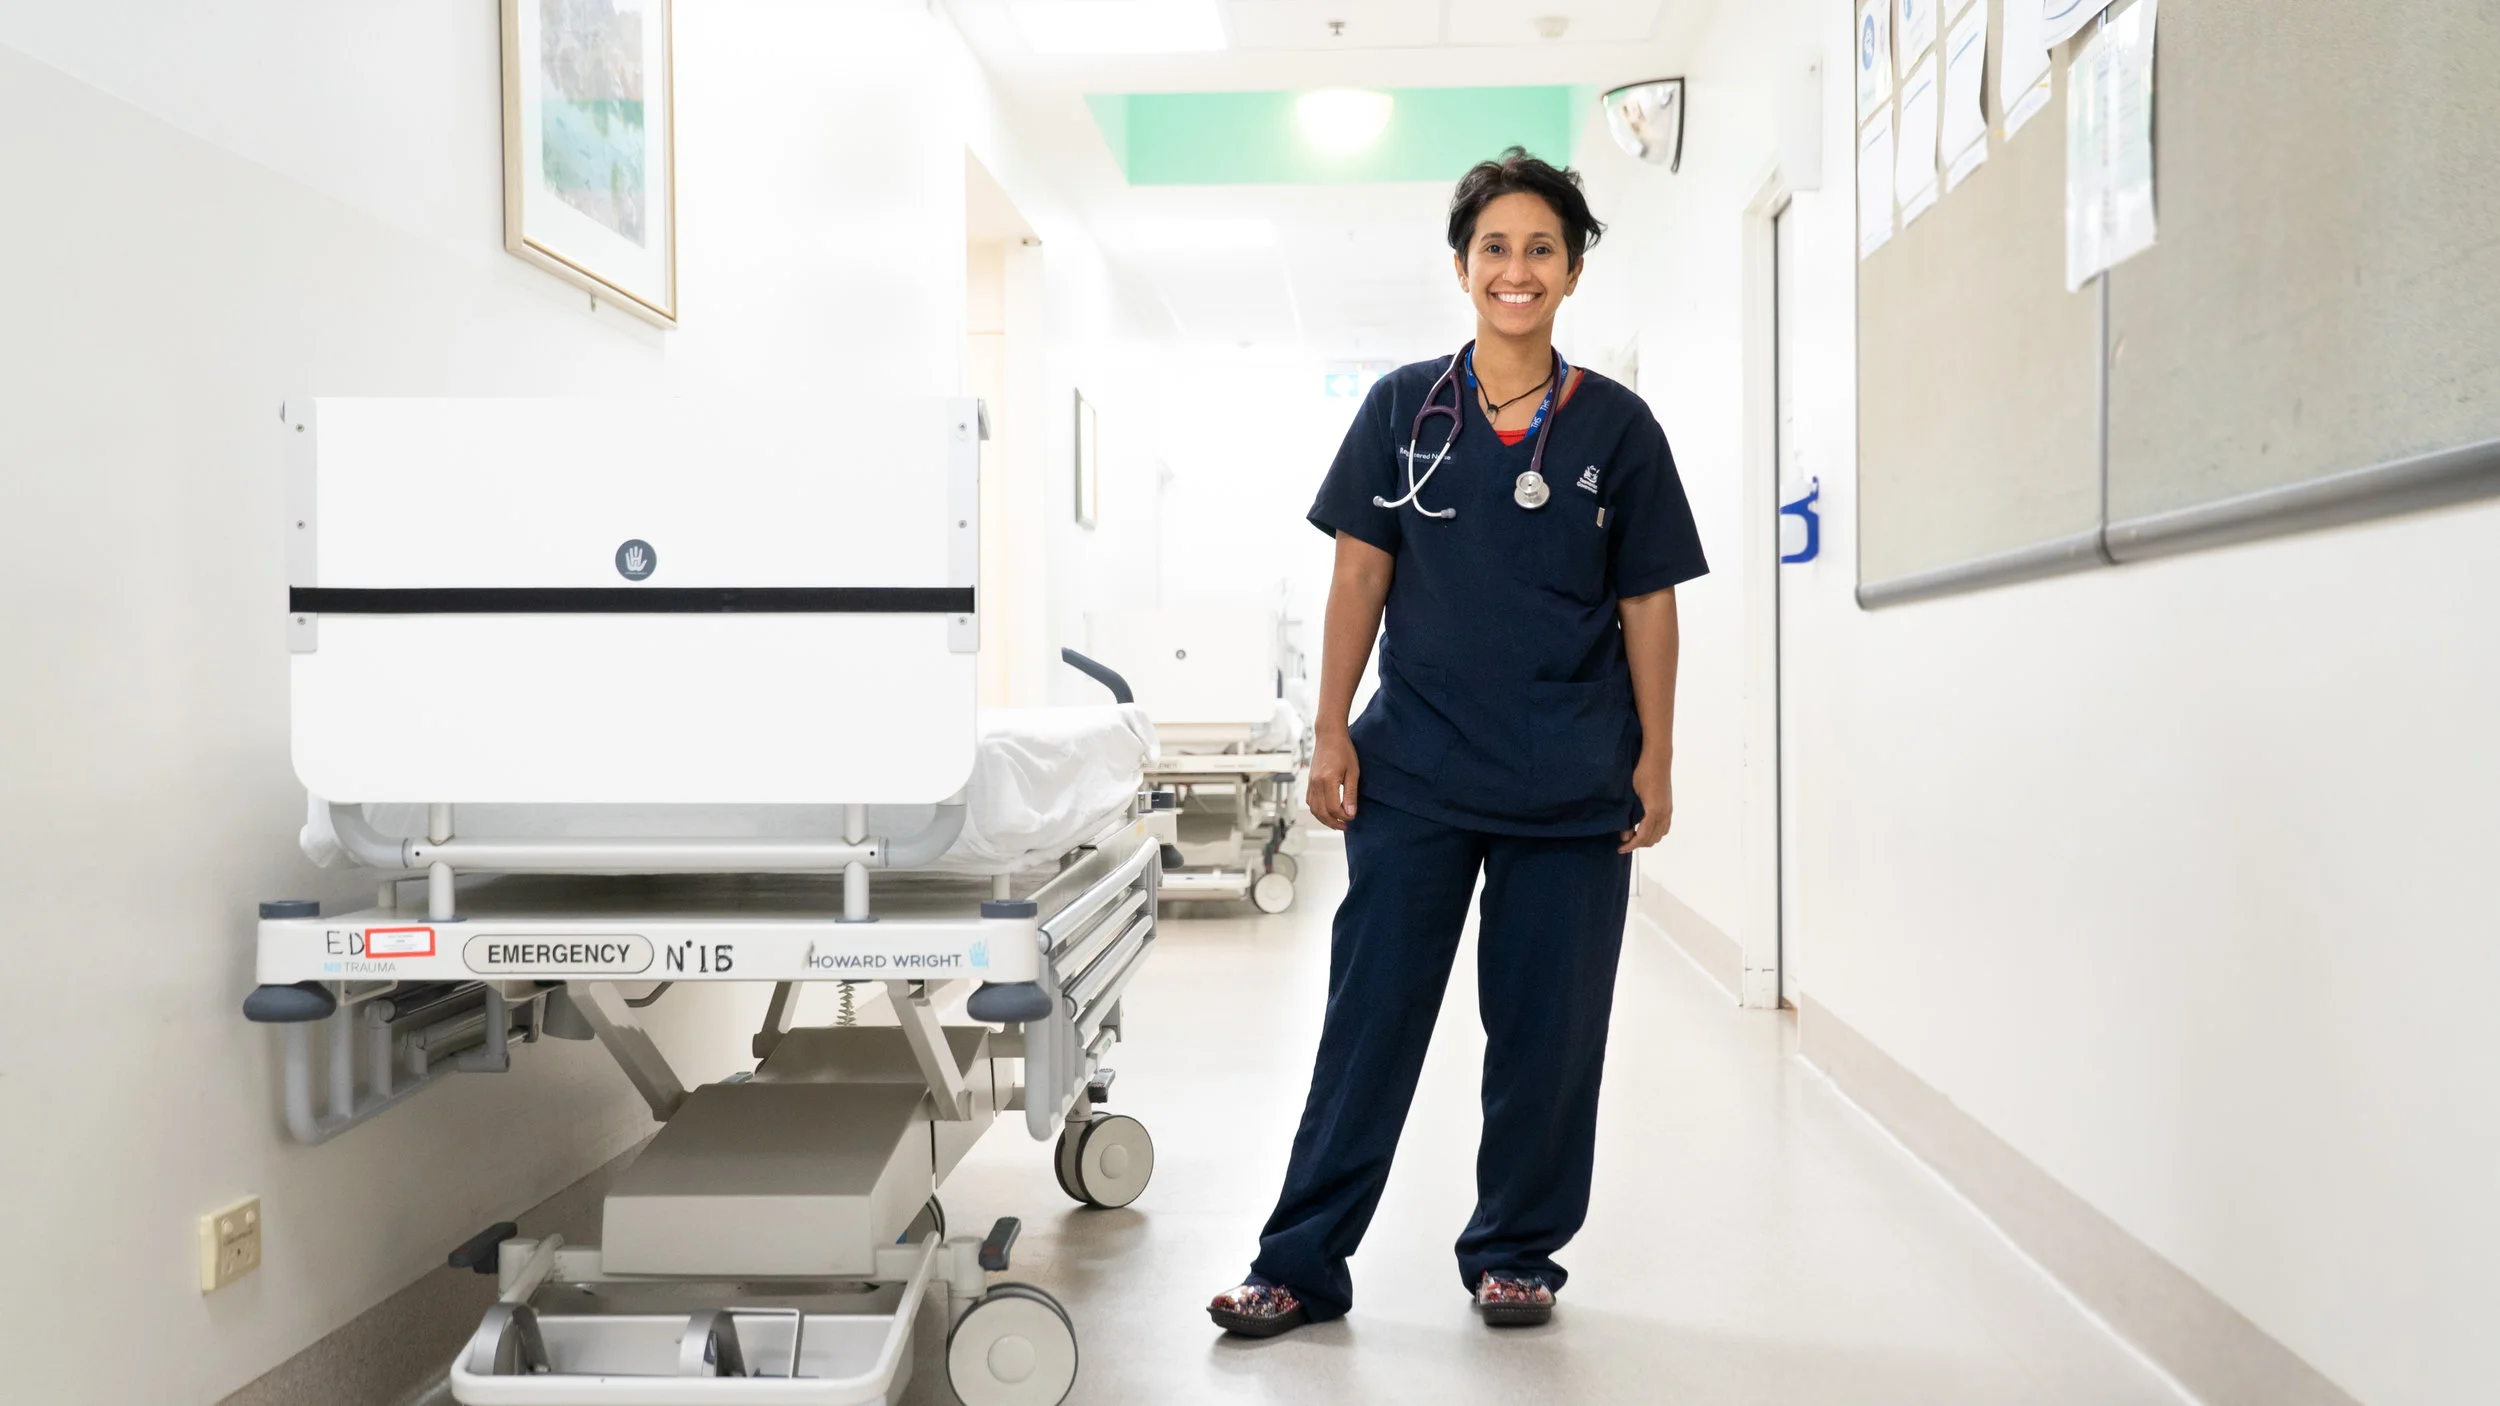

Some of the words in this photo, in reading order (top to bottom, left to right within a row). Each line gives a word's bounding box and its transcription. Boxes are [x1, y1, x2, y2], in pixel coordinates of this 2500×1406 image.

[1400, 447, 1430, 460] Regtered
[1431, 453, 1452, 461] Nse
[326, 930, 365, 956] ED
[488, 944, 631, 964] EMERGENCY
[808, 954, 887, 969] HOWARD
[893, 954, 962, 968] WRIGHT
[345, 961, 397, 974] TRAUMA
